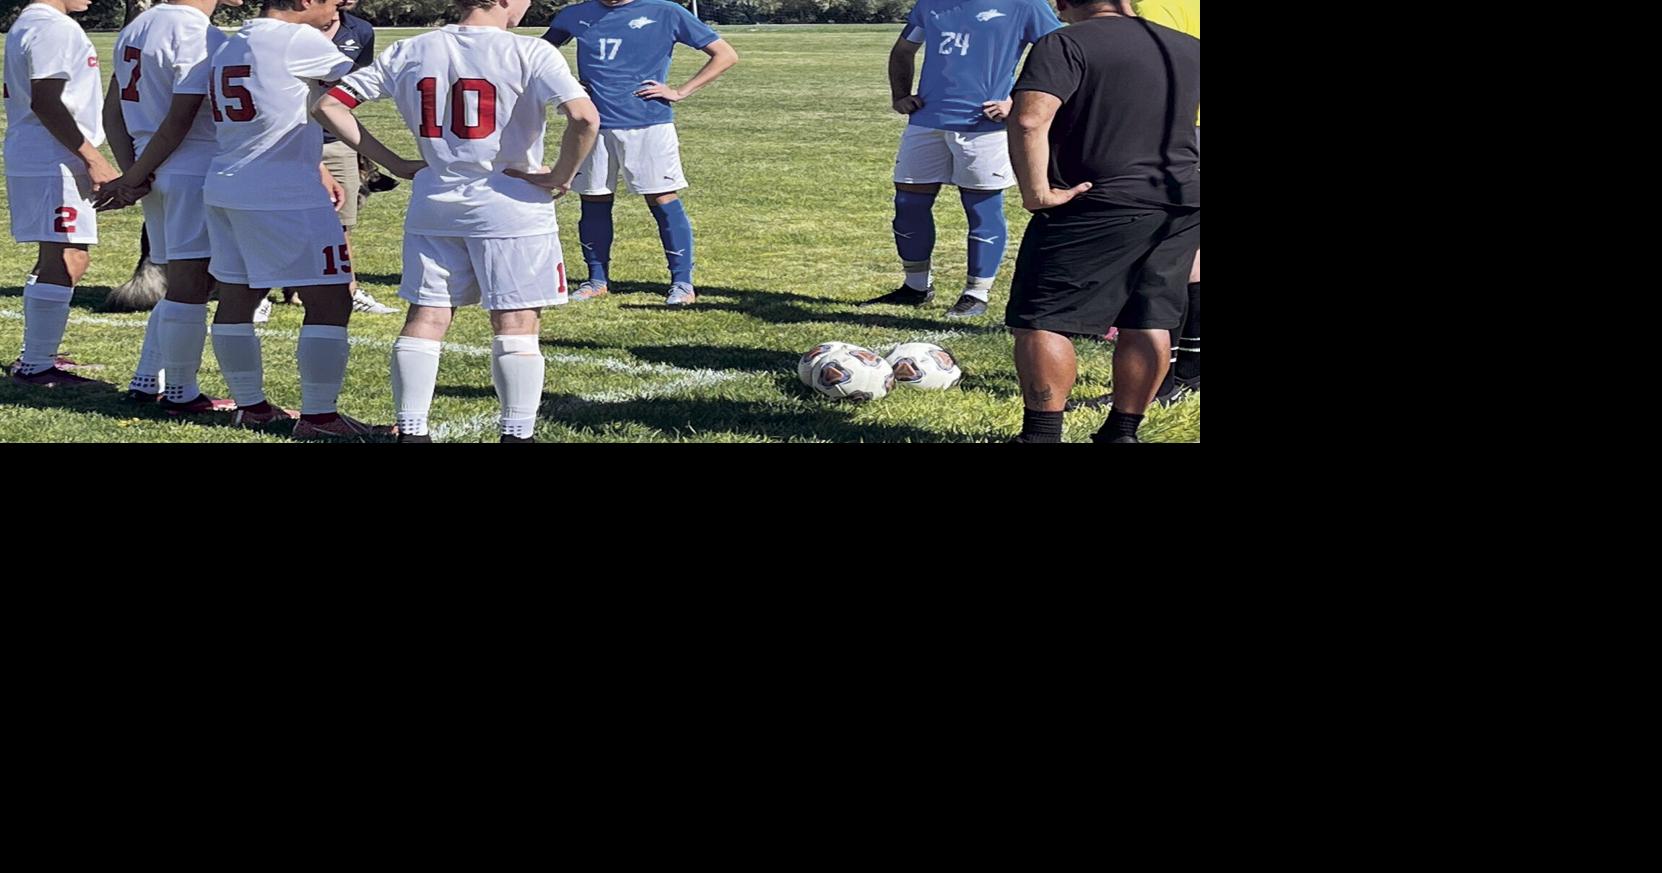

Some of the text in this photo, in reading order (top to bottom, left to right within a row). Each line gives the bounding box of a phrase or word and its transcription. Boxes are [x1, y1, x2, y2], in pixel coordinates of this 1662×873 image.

[599, 38, 623, 60] 17
[939, 31, 970, 56] 24
[121, 45, 142, 102] 7
[416, 77, 497, 140] 10
[54, 206, 77, 233] 2
[322, 244, 352, 275] 15
